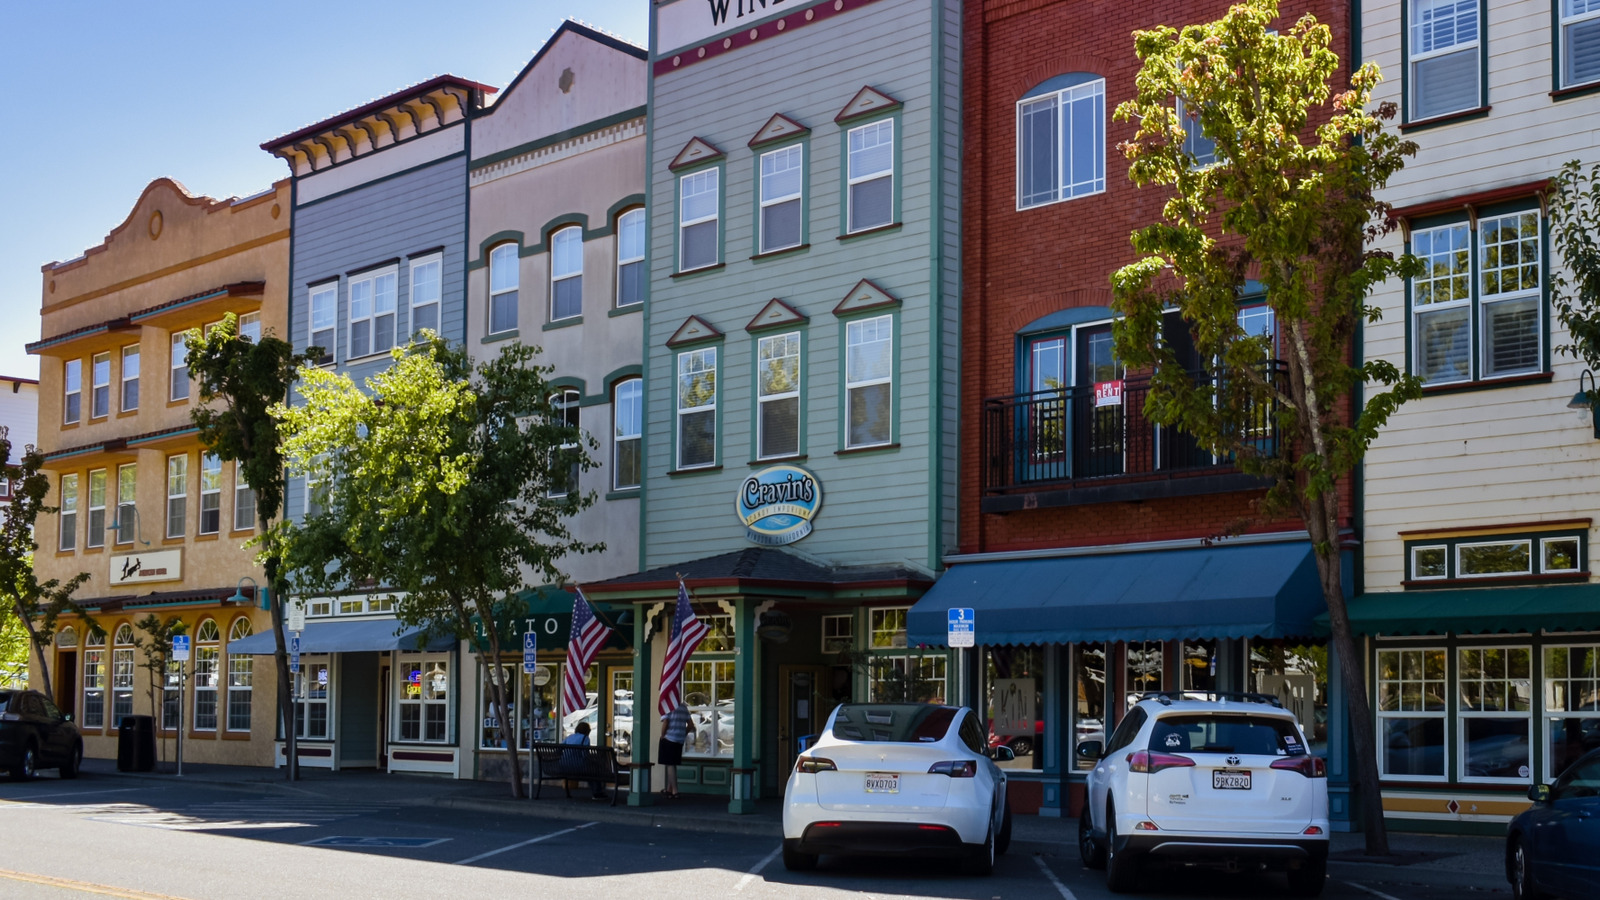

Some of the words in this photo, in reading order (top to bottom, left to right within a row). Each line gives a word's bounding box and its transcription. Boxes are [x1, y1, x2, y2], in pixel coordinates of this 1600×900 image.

[1096, 387, 1119, 399] RENT
[742, 473, 814, 509] Cravin's
[749, 507, 770, 522] CANDY
[773, 504, 808, 517] EMPORIUM
[746, 530, 772, 544] WINDSOR
[775, 525, 810, 545] CALIFORNIA
[958, 609, 965, 620] 3
[1215, 777, 1249, 787] 9BKZ820
